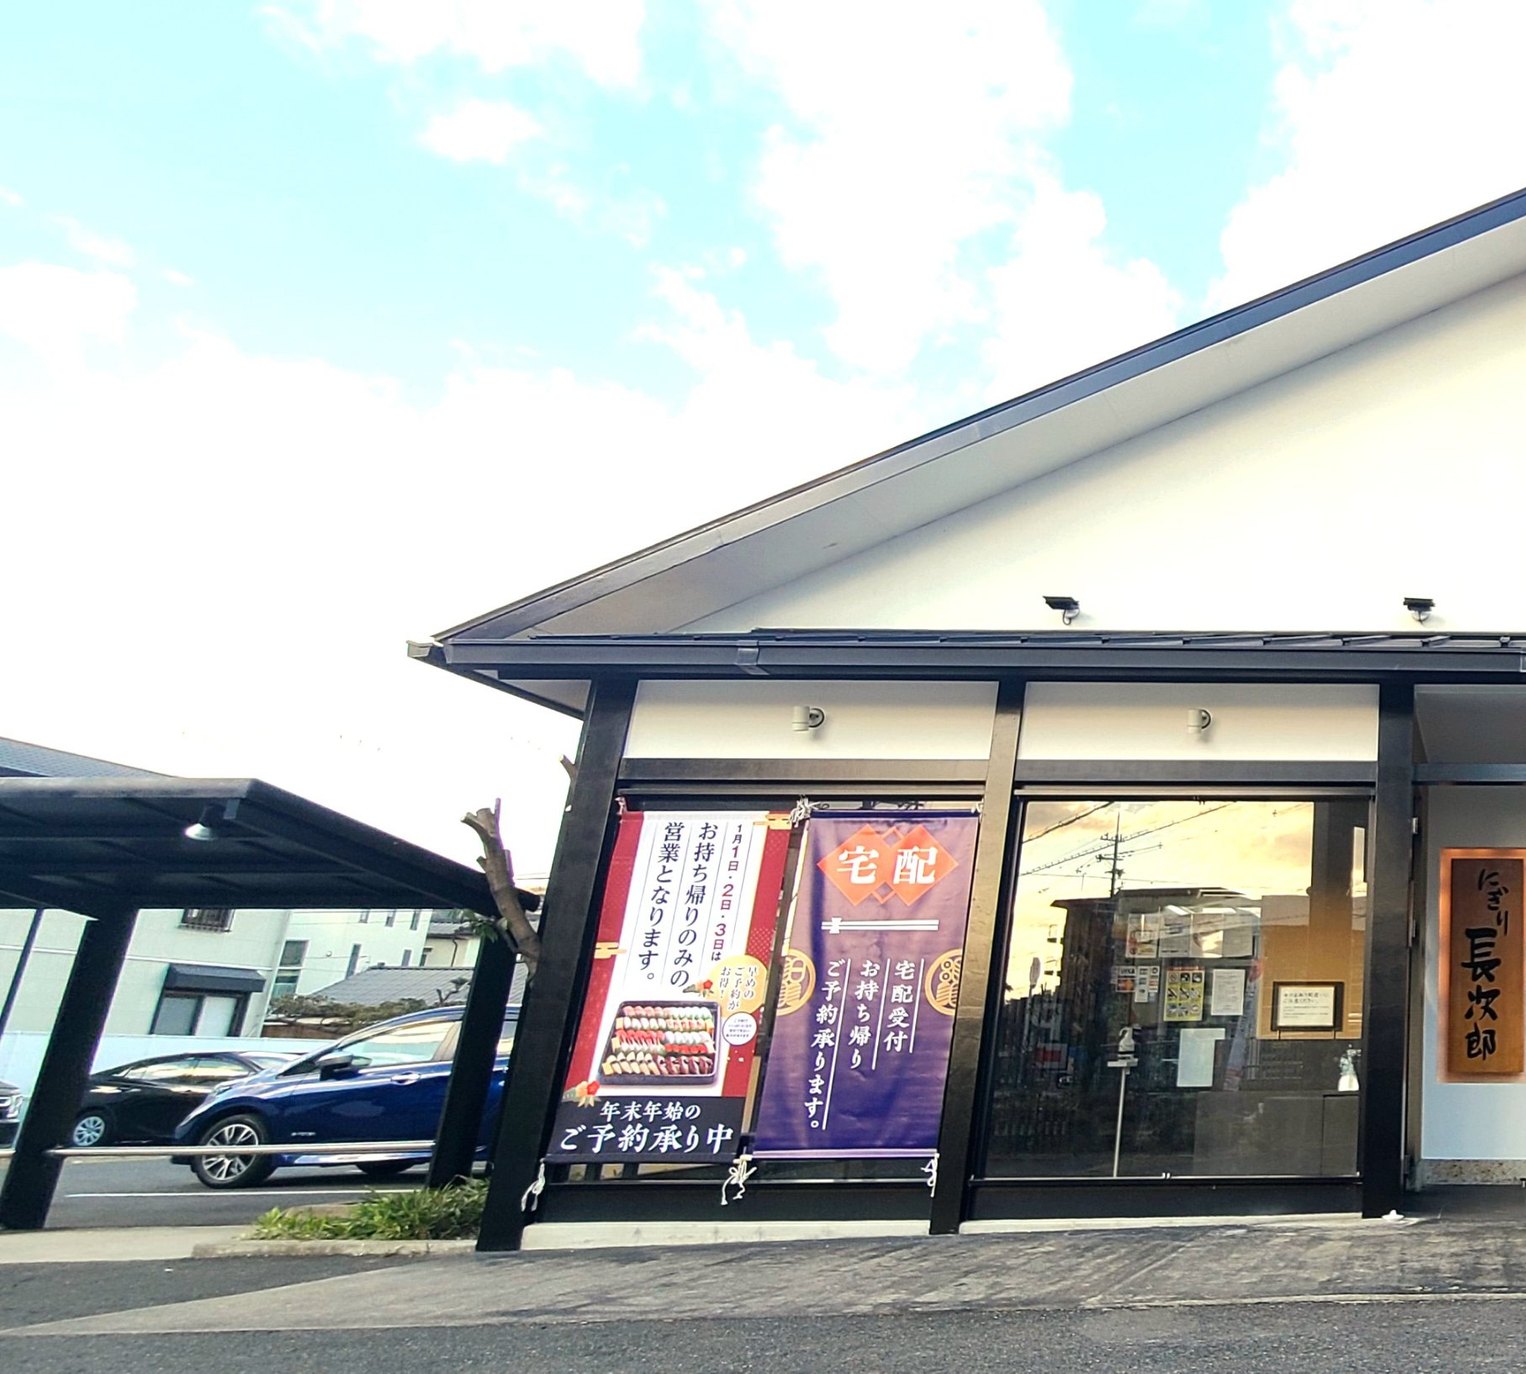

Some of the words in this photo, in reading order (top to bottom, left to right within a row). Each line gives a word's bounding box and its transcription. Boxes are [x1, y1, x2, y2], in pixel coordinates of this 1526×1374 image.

[638, 821, 685, 980] 営業となります。
[670, 822, 718, 988] お持ち帰りのみの
[711, 824, 742, 961] 1月1日・2日・3日は
[836, 845, 938, 886] 宅配
[1478, 868, 1509, 936] にぎり
[728, 967, 745, 1011] ご予約が
[744, 967, 757, 999] 早めの
[848, 959, 880, 1070] お持ち帰り
[883, 960, 915, 1053] 宅配受付
[1461, 928, 1501, 1060] 長次郎
[803, 959, 844, 1129] ご予約承ります。
[559, 1122, 735, 1155] ご予約承り中
[599, 1100, 702, 1123] 年末年始の
